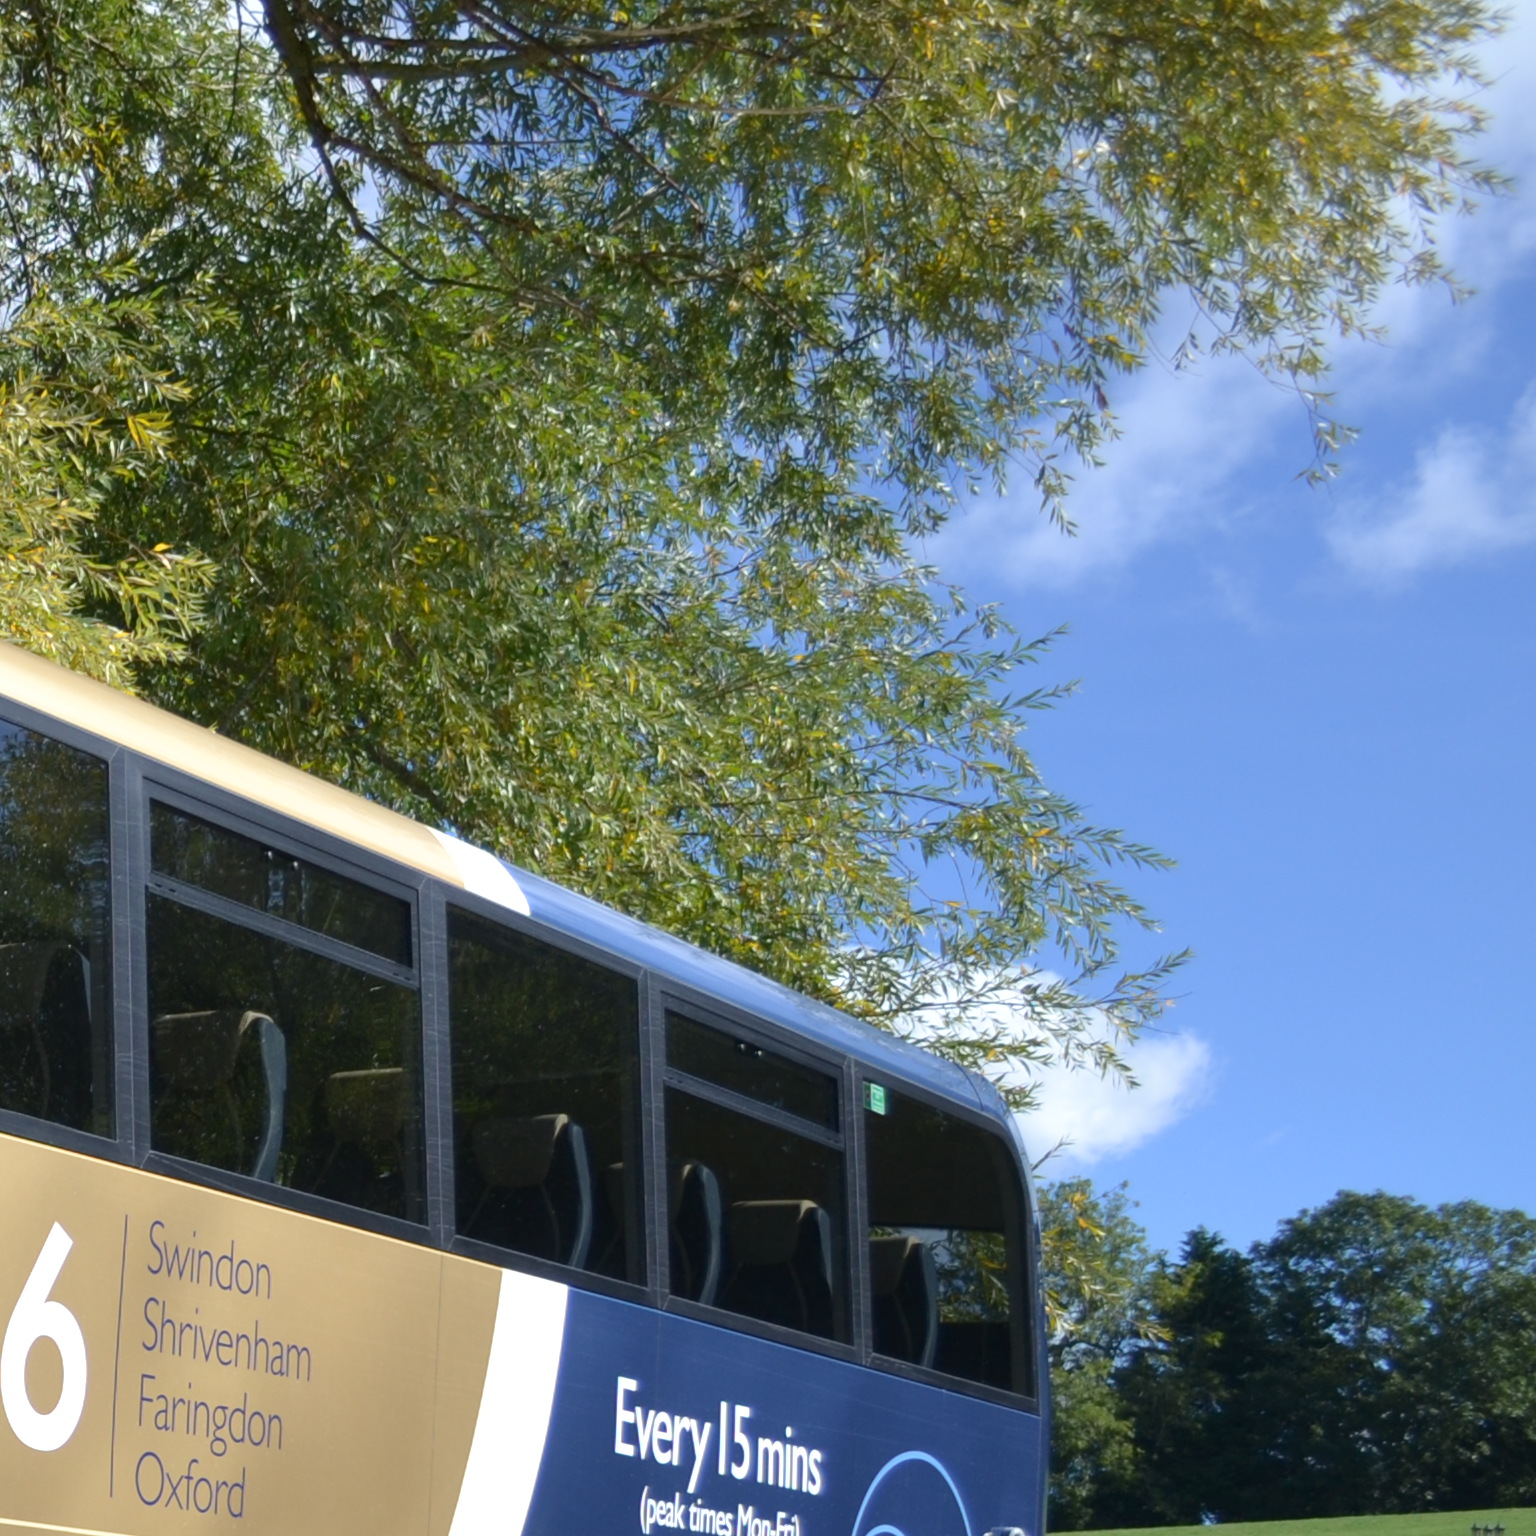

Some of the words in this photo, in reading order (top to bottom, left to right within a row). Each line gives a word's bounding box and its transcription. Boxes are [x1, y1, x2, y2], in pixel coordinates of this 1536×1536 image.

[147, 1219, 272, 1300] Swindon
[142, 1296, 313, 1382] Shrivenham
[138, 1373, 284, 1457] Faringdon
[614, 1375, 712, 1495] Every
[718, 1400, 751, 1480] 15
[756, 1425, 823, 1496] mins
[135, 1451, 247, 1519] Oxford
[640, 1485, 686, 1535] (peak
